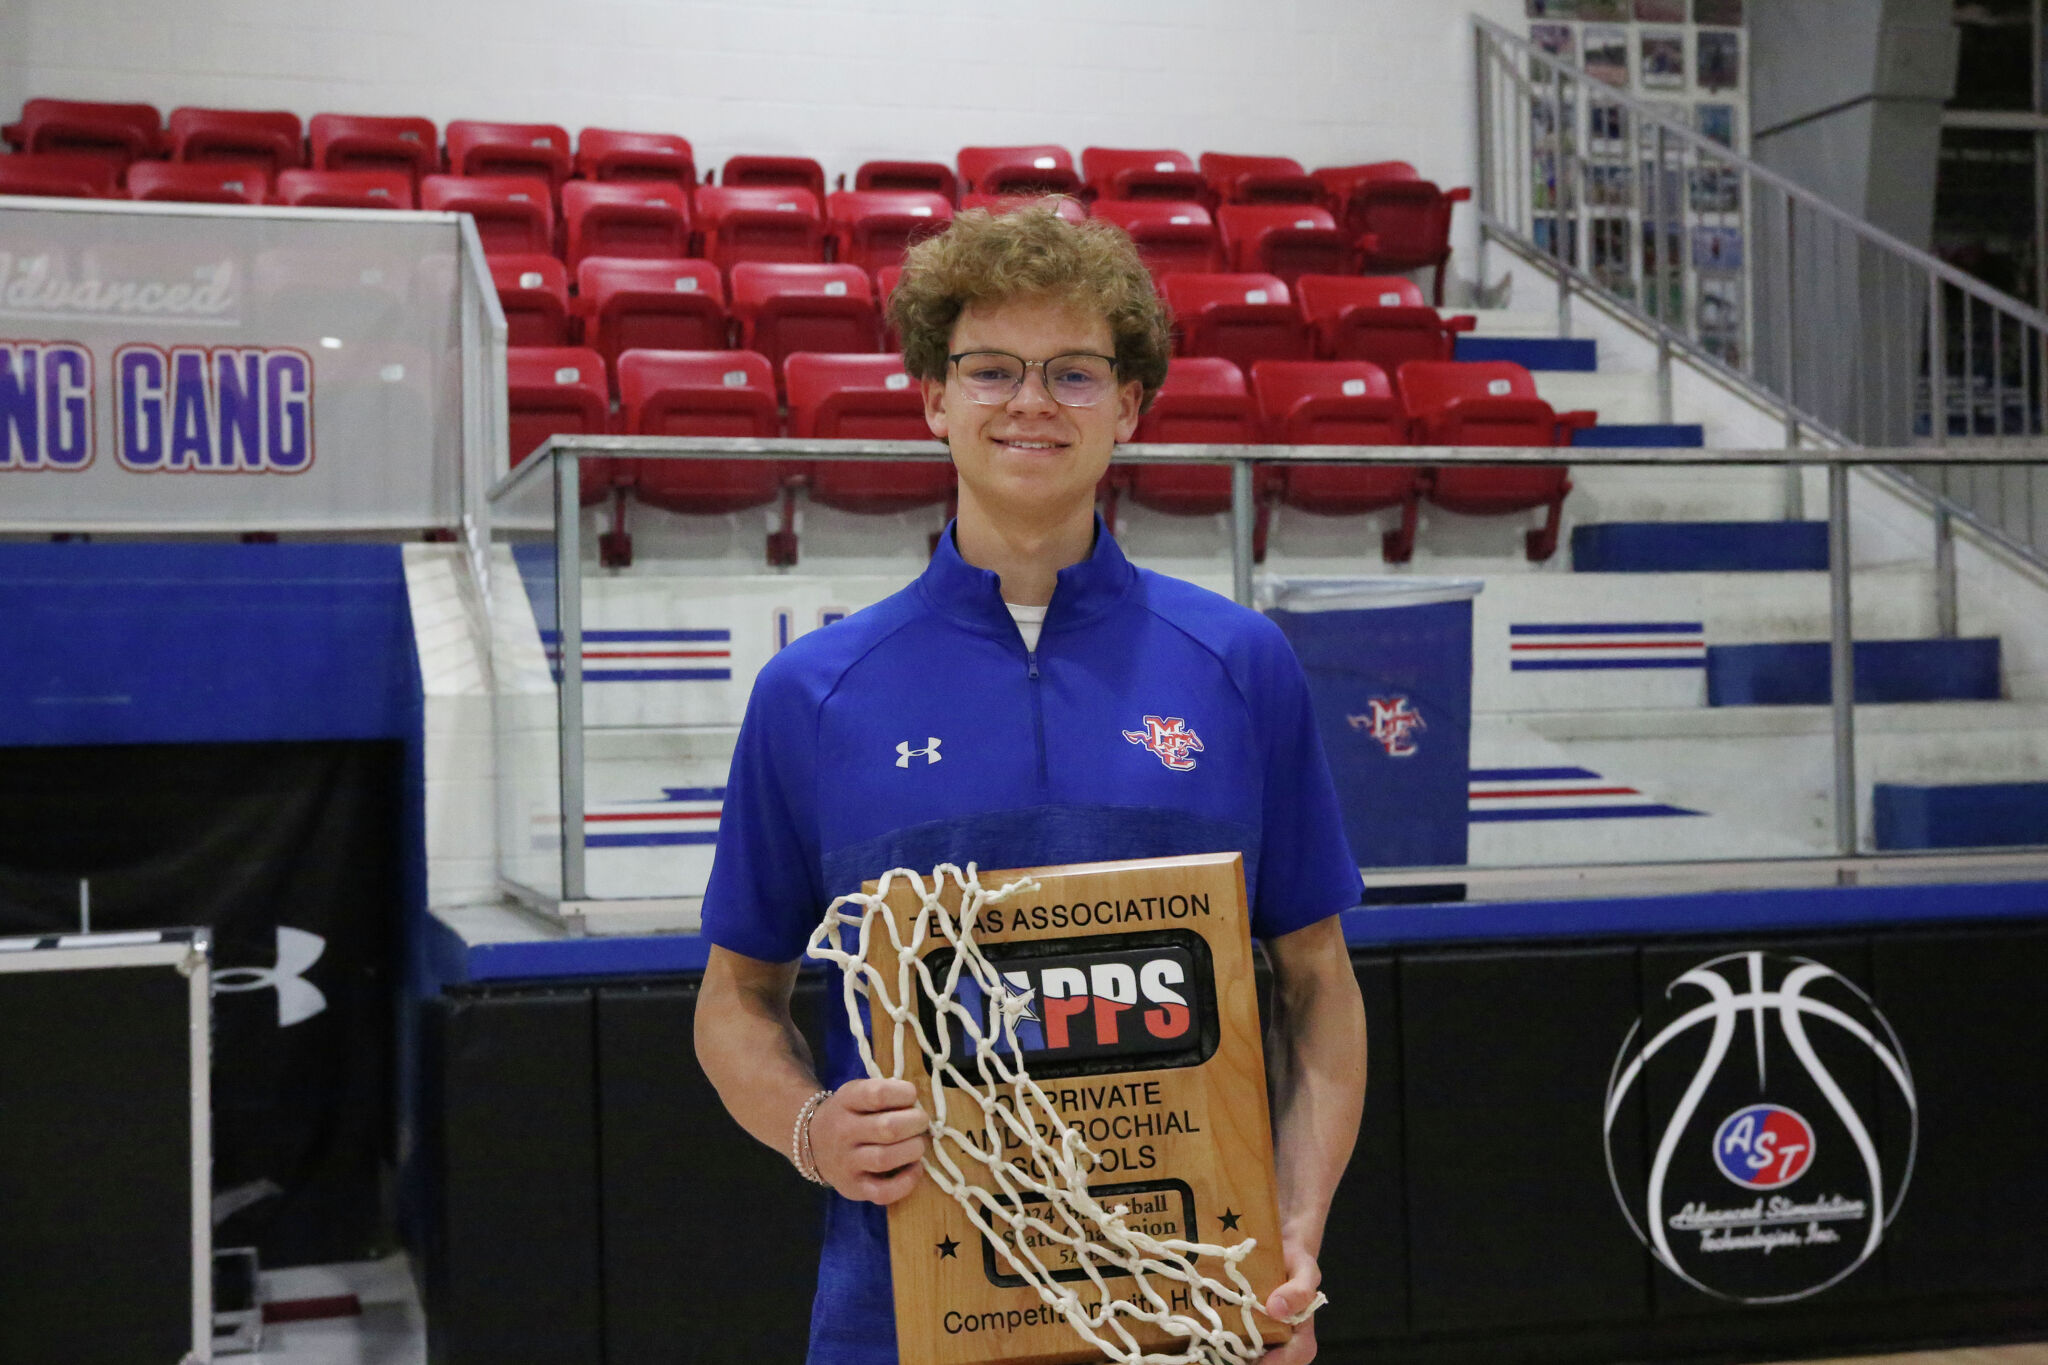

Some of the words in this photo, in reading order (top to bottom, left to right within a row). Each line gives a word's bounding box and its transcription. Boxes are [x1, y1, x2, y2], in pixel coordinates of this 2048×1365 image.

[113, 343, 315, 474] GANG
[1012, 893, 1210, 932] ASSOCIATION
[1041, 1082, 1162, 1115] PRIVATE
[1011, 1145, 1156, 1179] SCOLS
[1725, 1115, 1806, 1180] AST
[1008, 1207, 1055, 1227] 24
